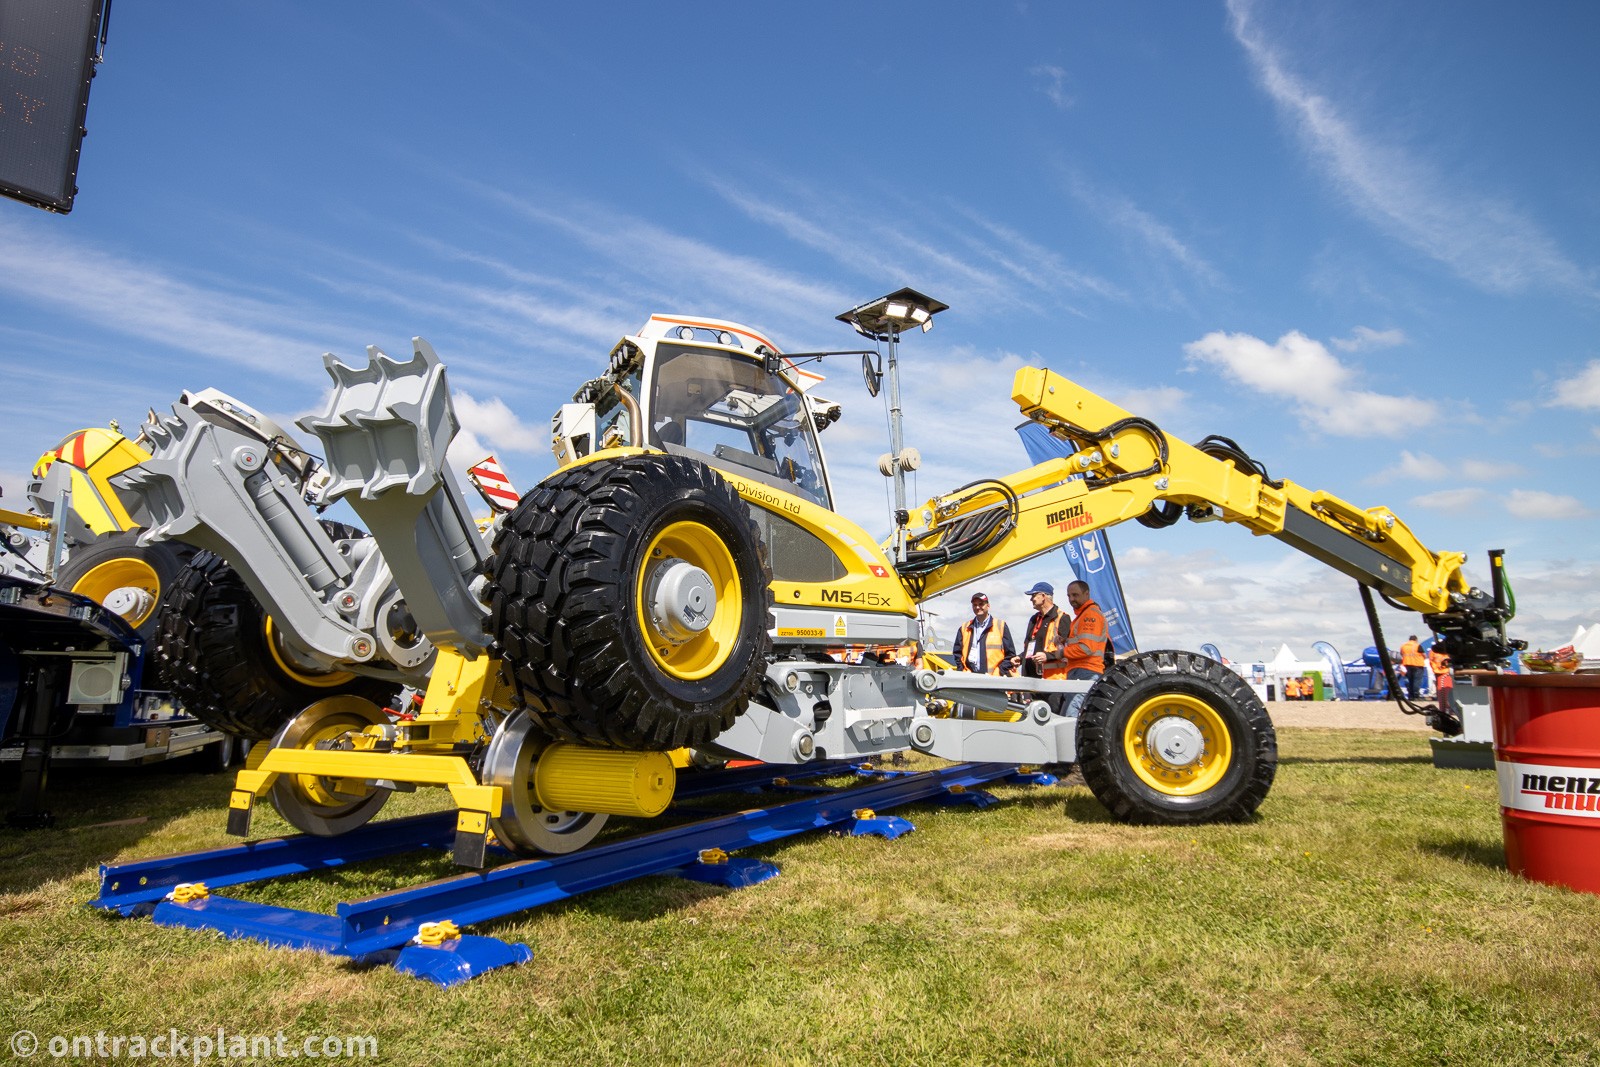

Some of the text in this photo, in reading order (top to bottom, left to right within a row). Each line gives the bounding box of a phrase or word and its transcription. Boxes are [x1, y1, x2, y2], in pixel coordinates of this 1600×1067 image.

[737, 481, 801, 514] Division Ltd
[1046, 501, 1084, 526] menzi
[1058, 511, 1093, 533] muck
[821, 589, 891, 607] M545x
[1540, 792, 1600, 812] mu
